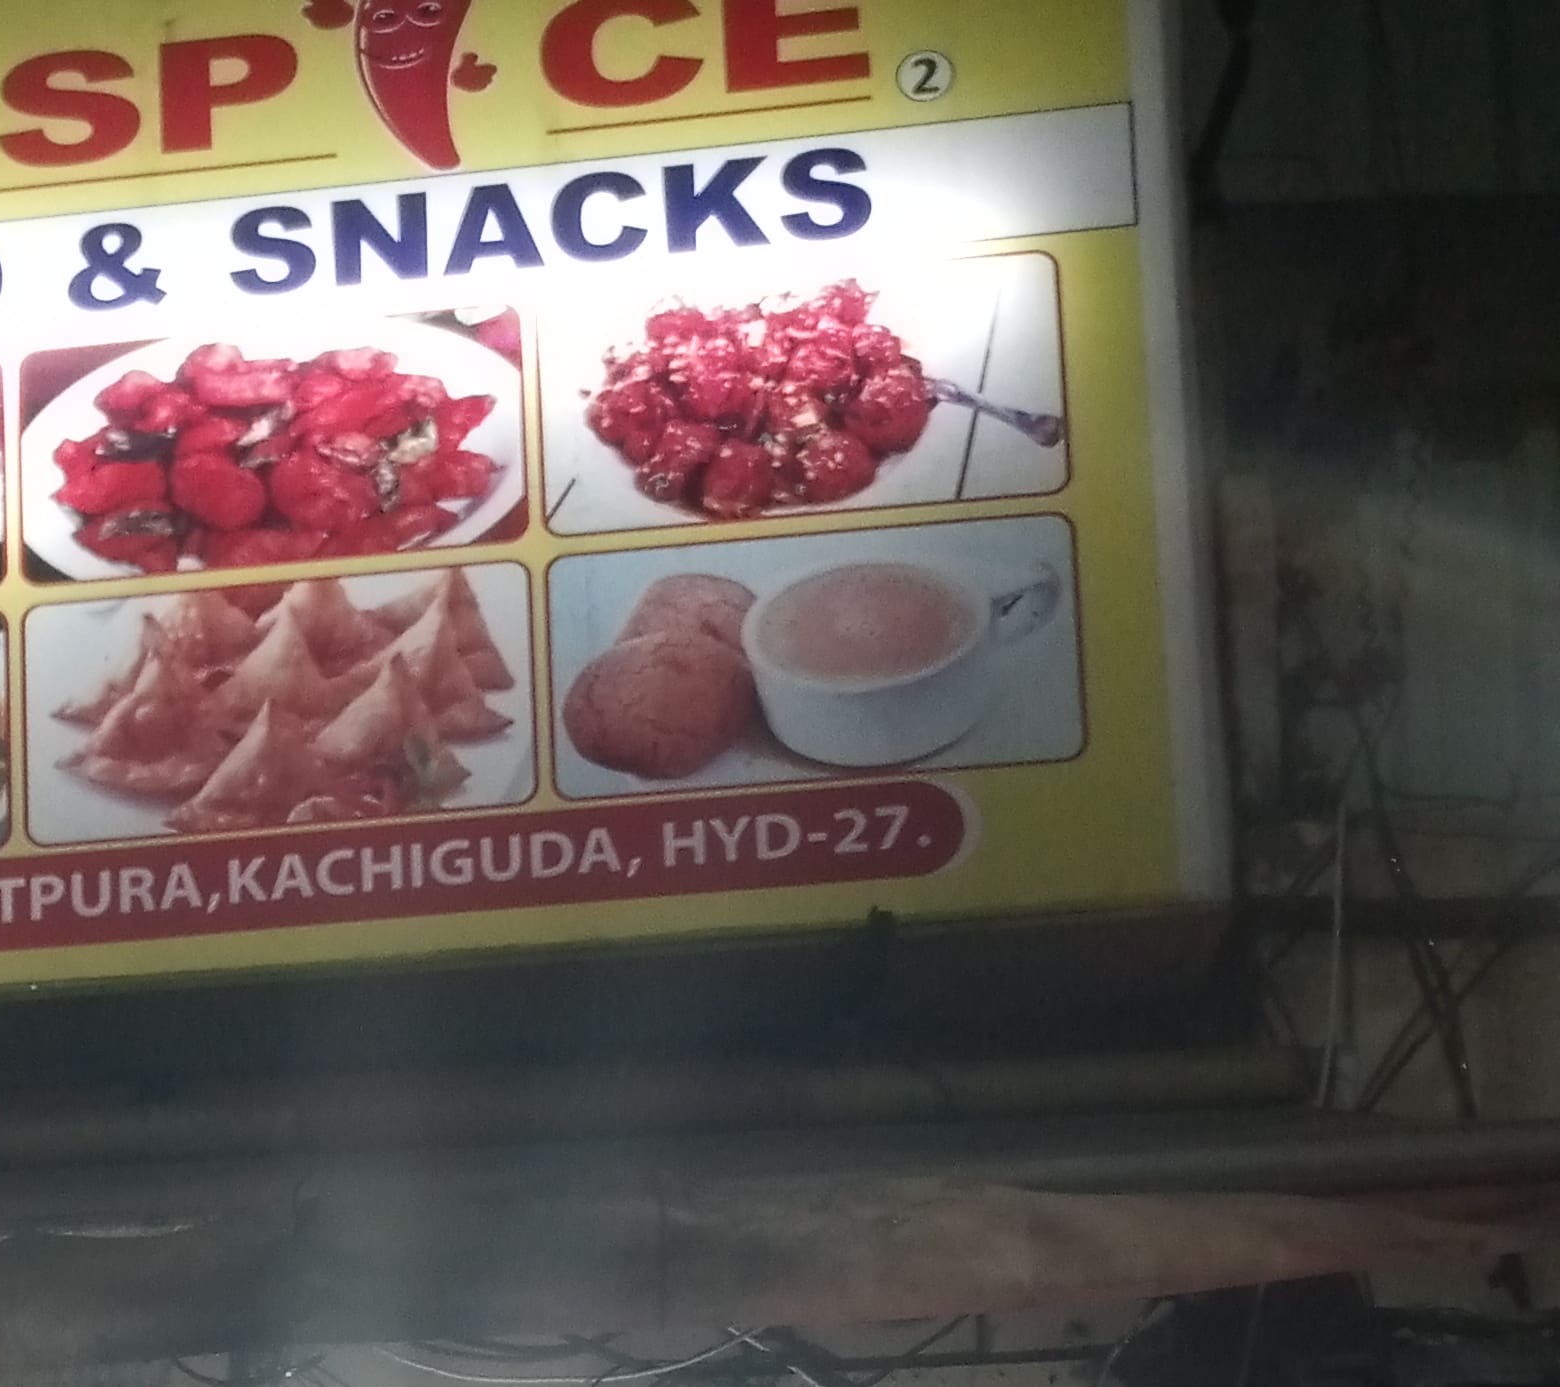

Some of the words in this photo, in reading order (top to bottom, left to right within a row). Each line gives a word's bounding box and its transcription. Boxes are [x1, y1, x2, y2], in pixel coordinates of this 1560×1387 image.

[912, 57, 940, 95] 2
[68, 223, 167, 309] &
[229, 145, 874, 297] SNACKS
[664, 805, 931, 866] HYD-27.
